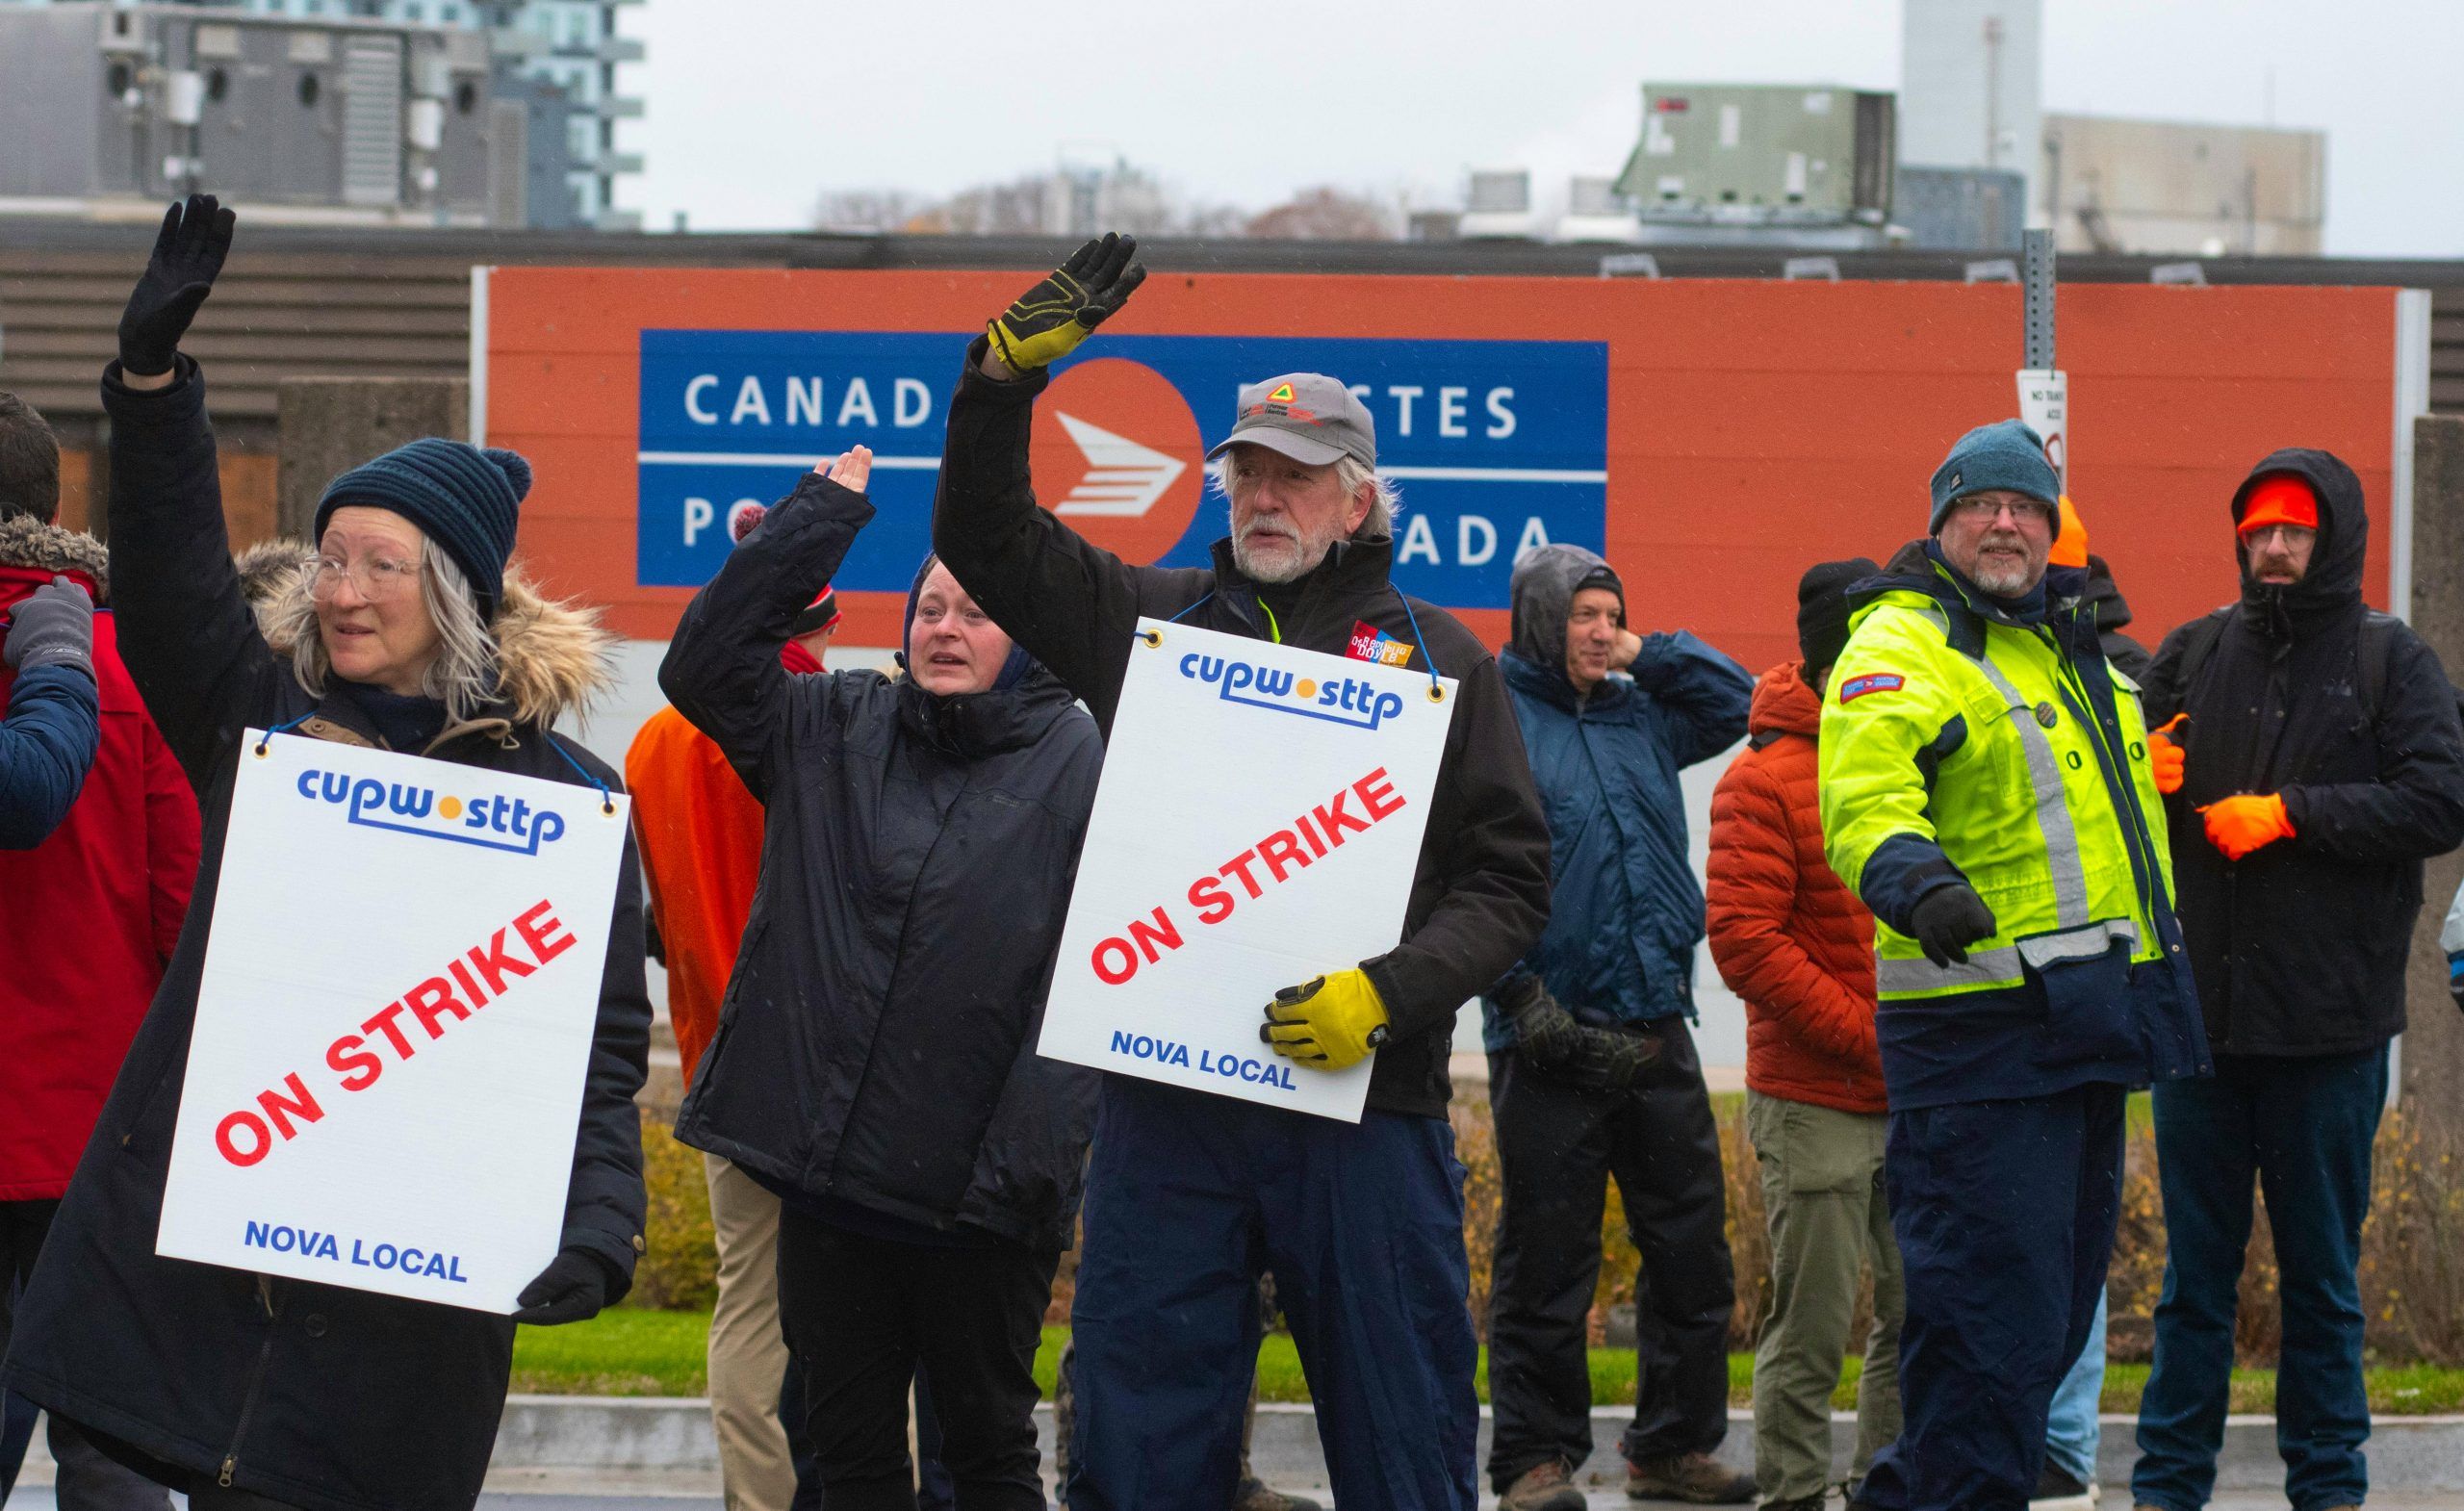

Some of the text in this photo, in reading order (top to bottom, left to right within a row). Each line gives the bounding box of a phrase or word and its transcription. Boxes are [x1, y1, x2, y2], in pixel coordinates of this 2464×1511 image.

[684, 374, 949, 427] CANAD
[1091, 766, 1407, 985] ON STRIKE
[215, 898, 578, 1167] ON STRIKE
[1111, 1030, 1296, 1090] NOVA LOCAL
[244, 1220, 468, 1283] NOVA LOCAL
